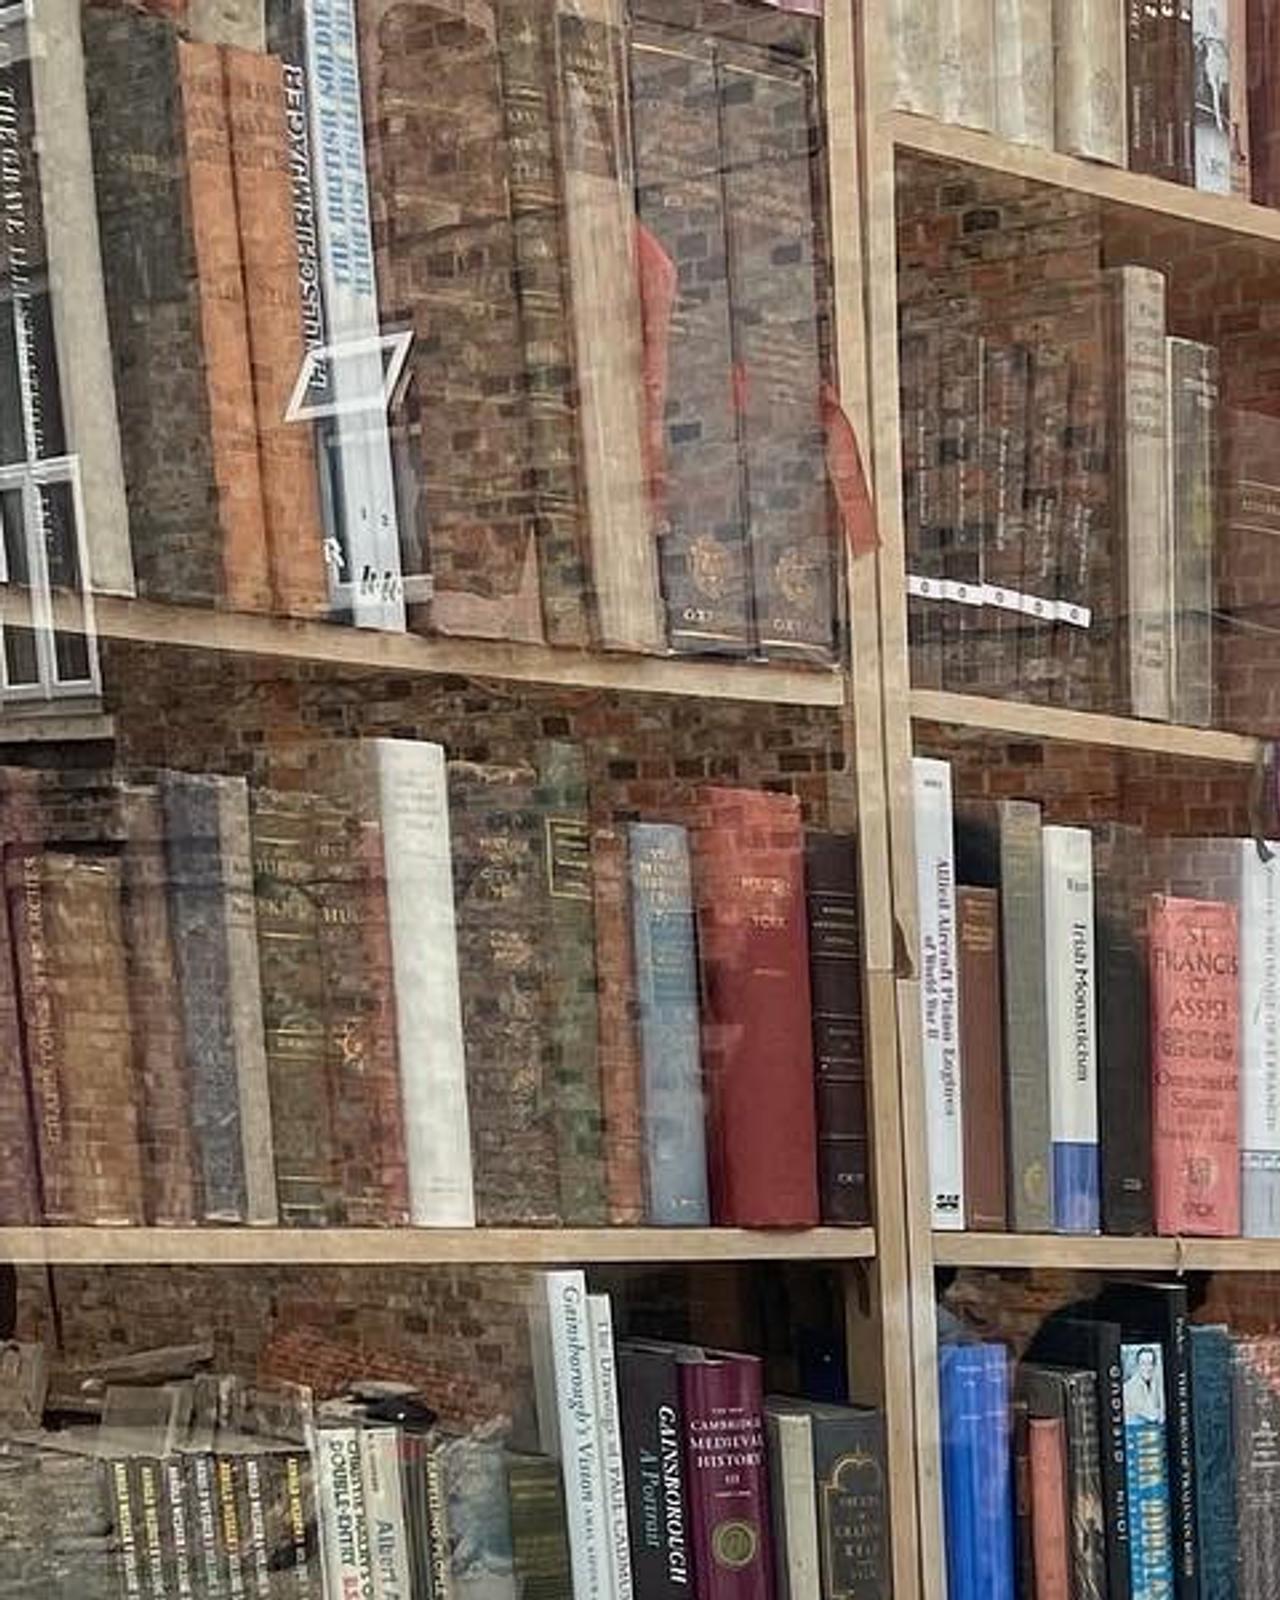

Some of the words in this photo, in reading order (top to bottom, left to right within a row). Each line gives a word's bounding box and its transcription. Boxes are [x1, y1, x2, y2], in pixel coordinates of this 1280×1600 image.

[1155, 951, 1237, 974] FRANCIS
[697, 1454, 761, 1467] HISTORY
[651, 1404, 692, 1585] GAINSBOROUGH
